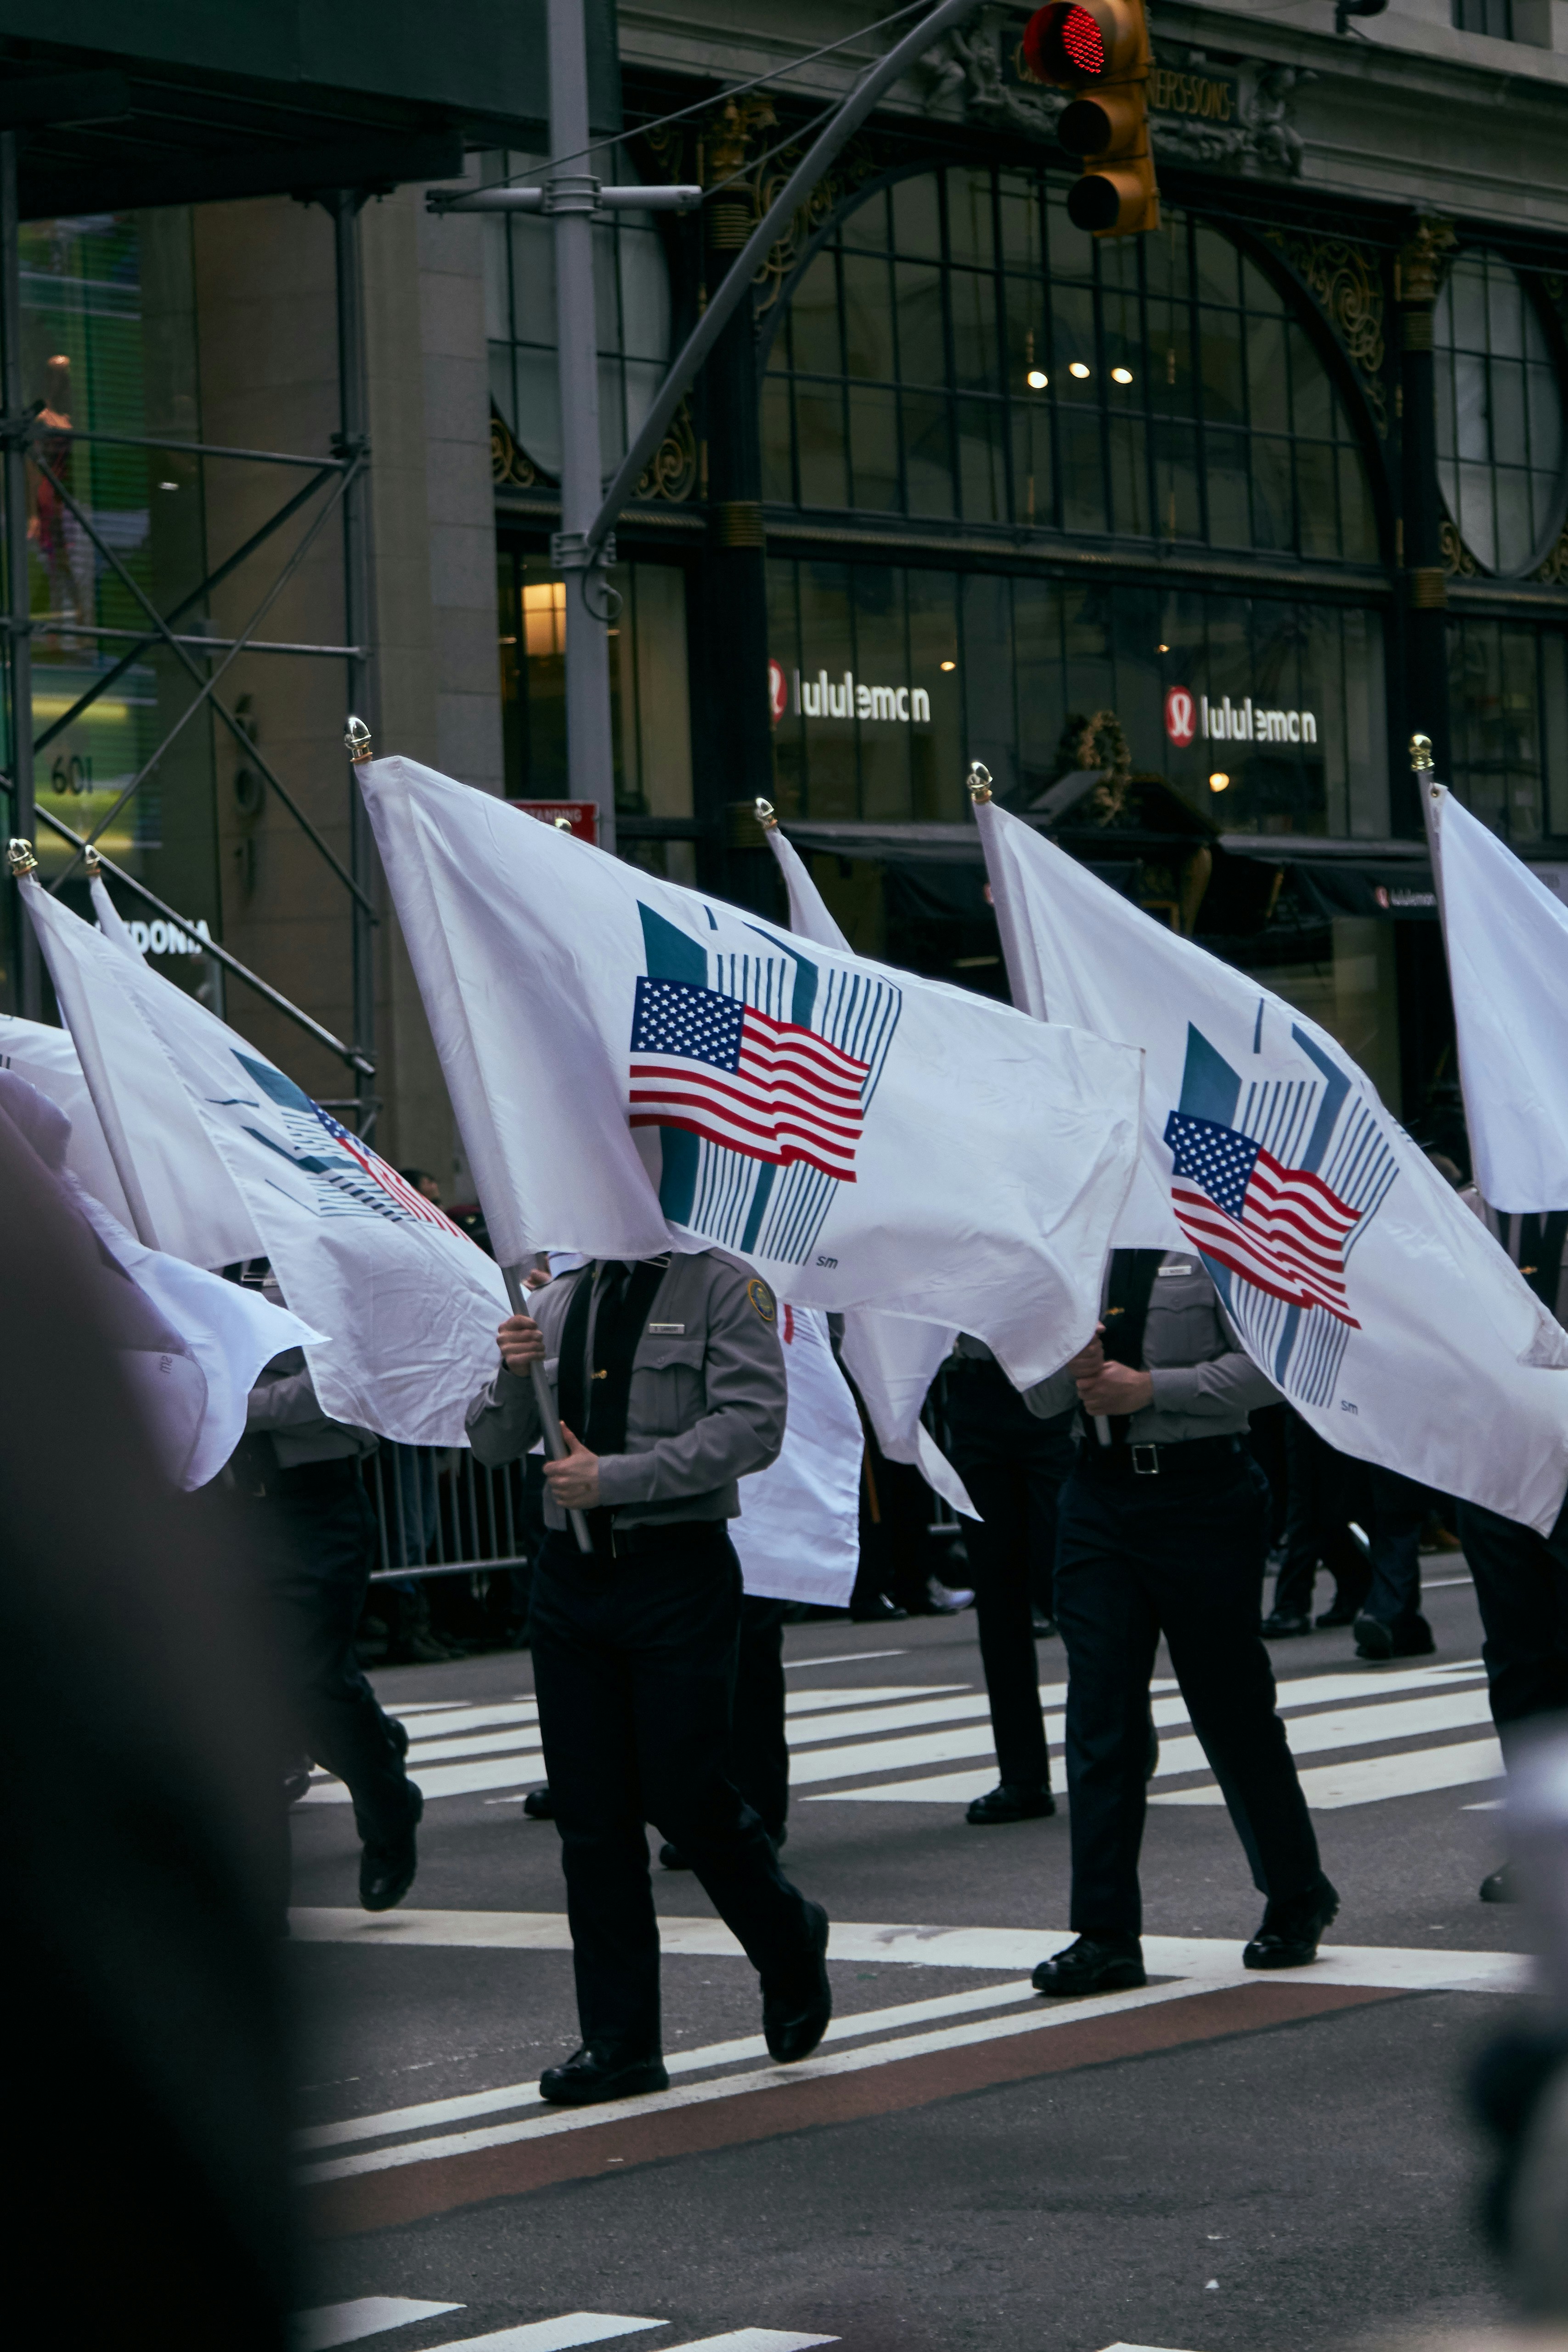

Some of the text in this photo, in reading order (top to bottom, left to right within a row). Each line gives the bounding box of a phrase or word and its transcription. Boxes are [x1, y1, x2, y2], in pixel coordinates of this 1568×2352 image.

[793, 668, 931, 722] lululemon
[1201, 694, 1317, 744] lululemon
[51, 755, 93, 795] 601
[816, 1256, 838, 1269] sm
[1341, 1400, 1358, 1416] sm
